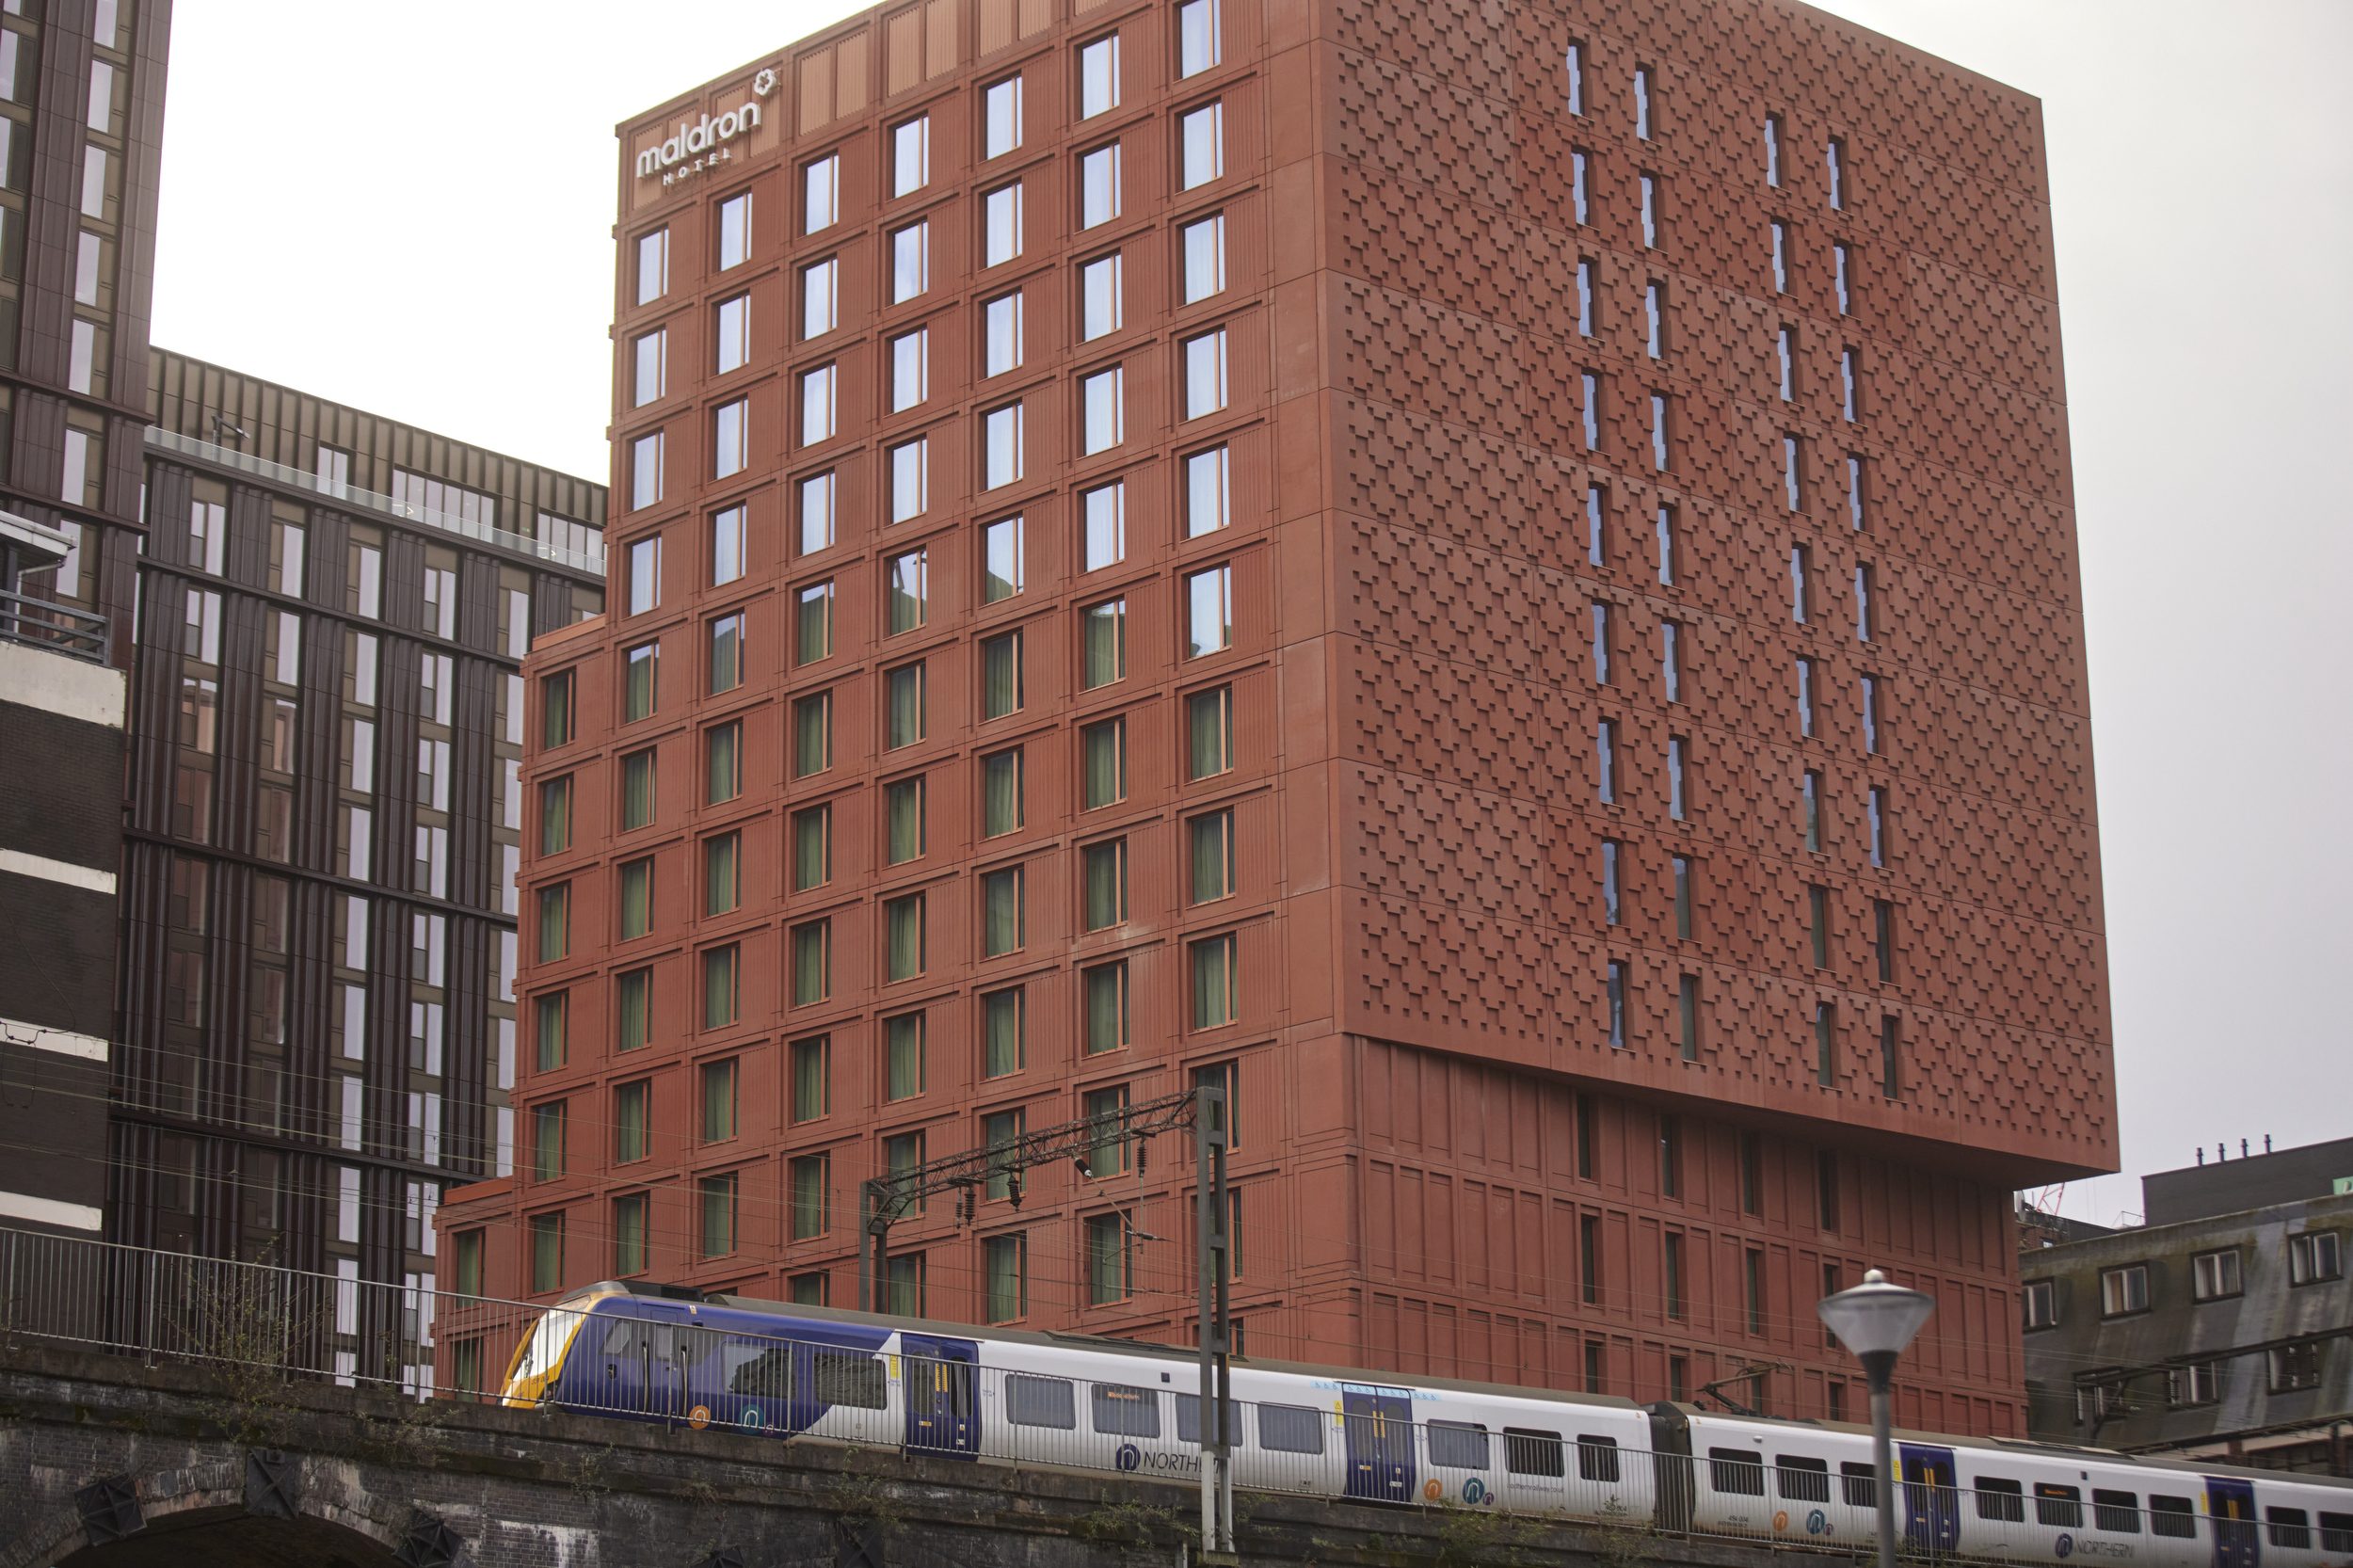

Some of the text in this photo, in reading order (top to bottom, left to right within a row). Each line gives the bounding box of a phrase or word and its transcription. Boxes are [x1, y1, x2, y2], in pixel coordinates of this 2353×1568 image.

[637, 102, 760, 178] maldron
[663, 148, 732, 185] HOTEL
[1144, 1451, 1221, 1475] NORTH
[2075, 1540, 2135, 1559] NORTHERN
